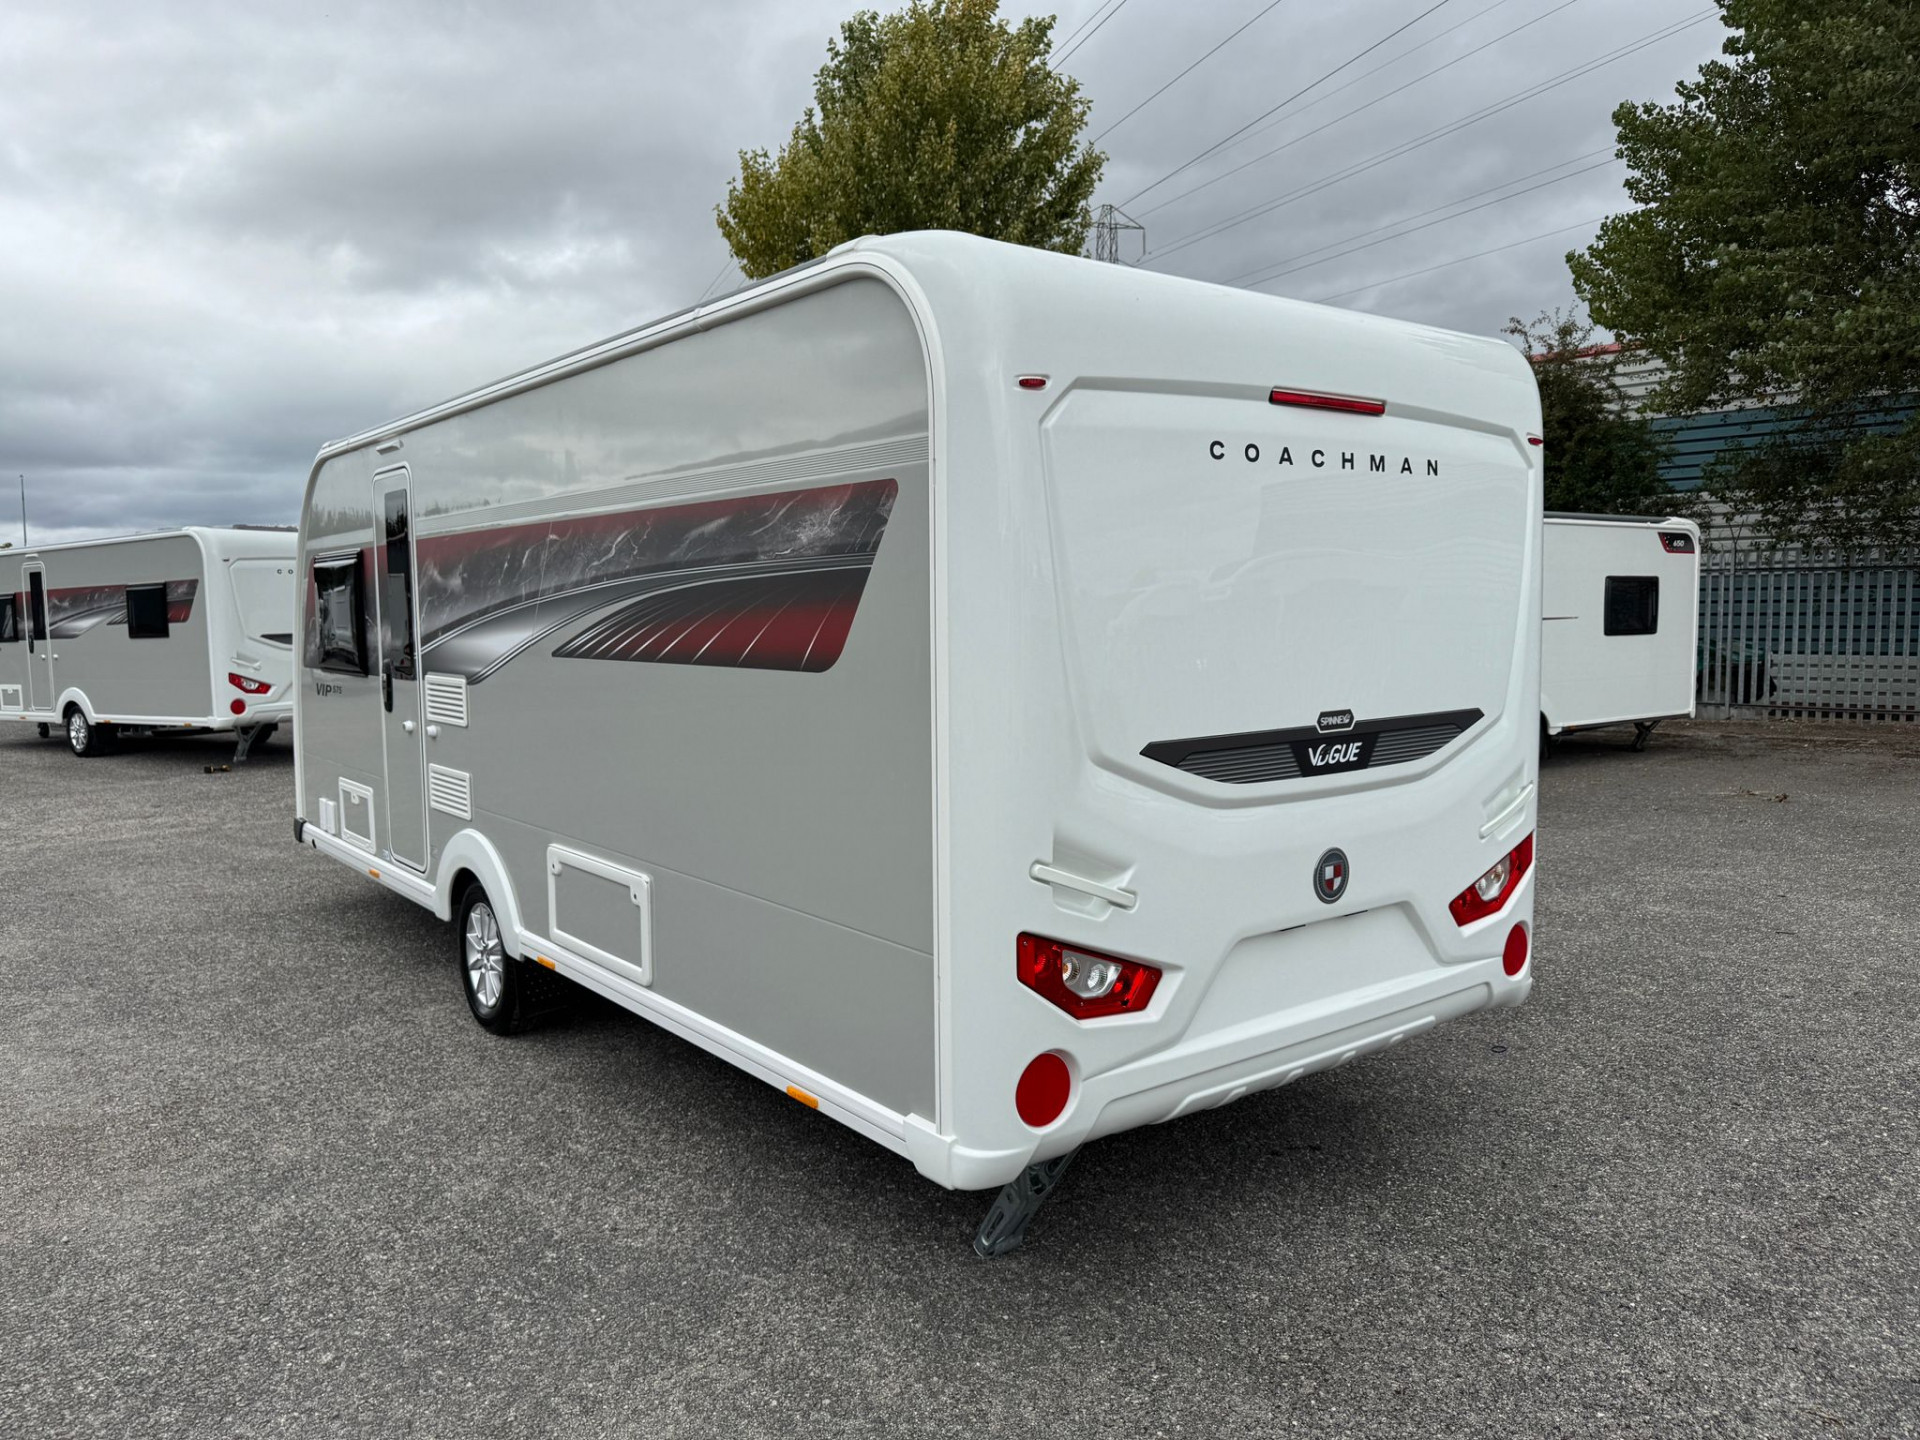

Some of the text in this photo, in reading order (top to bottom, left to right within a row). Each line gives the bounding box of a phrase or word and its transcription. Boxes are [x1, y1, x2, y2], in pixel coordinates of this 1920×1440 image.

[1209, 440, 1438, 476] COACHMAN
[316, 682, 332, 697] VIP
[1308, 741, 1363, 766] VOGUE
